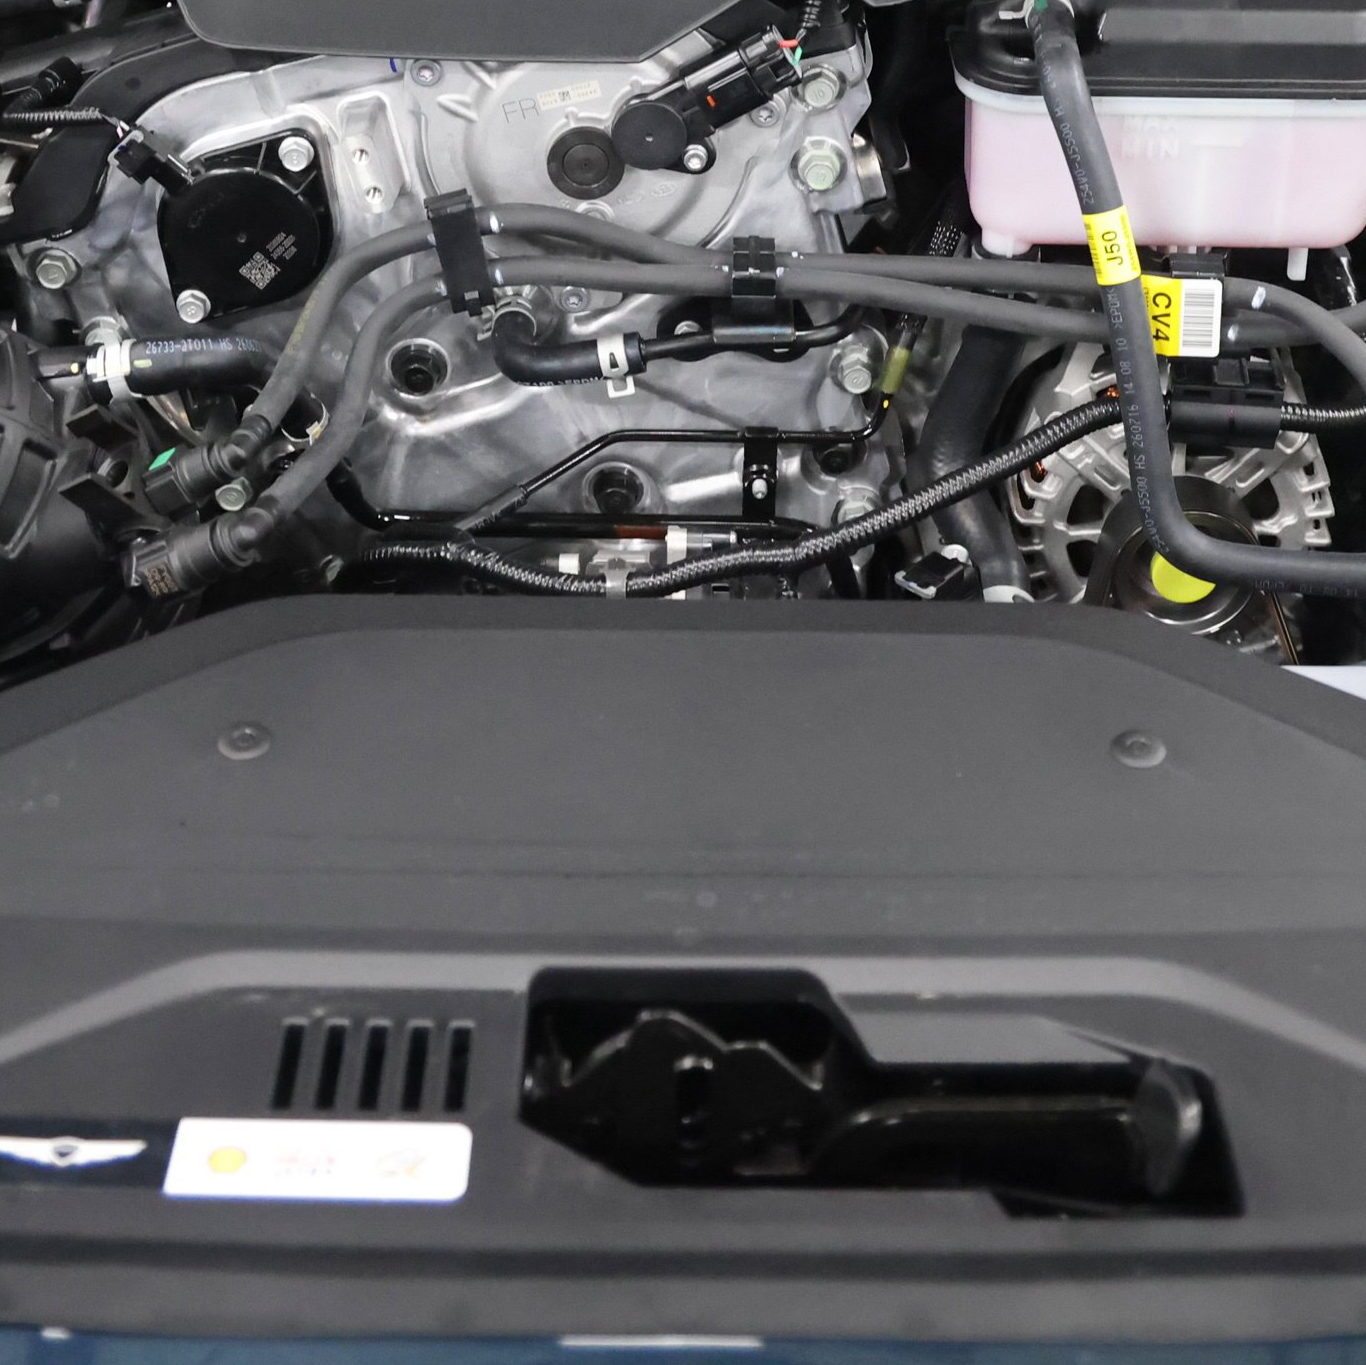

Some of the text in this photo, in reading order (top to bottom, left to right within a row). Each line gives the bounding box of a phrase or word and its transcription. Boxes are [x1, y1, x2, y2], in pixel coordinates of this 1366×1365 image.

[501, 97, 540, 123] FR
[1101, 230, 1124, 268] J50
[1152, 292, 1172, 340] CV4
[1128, 404, 1144, 448] 260716
